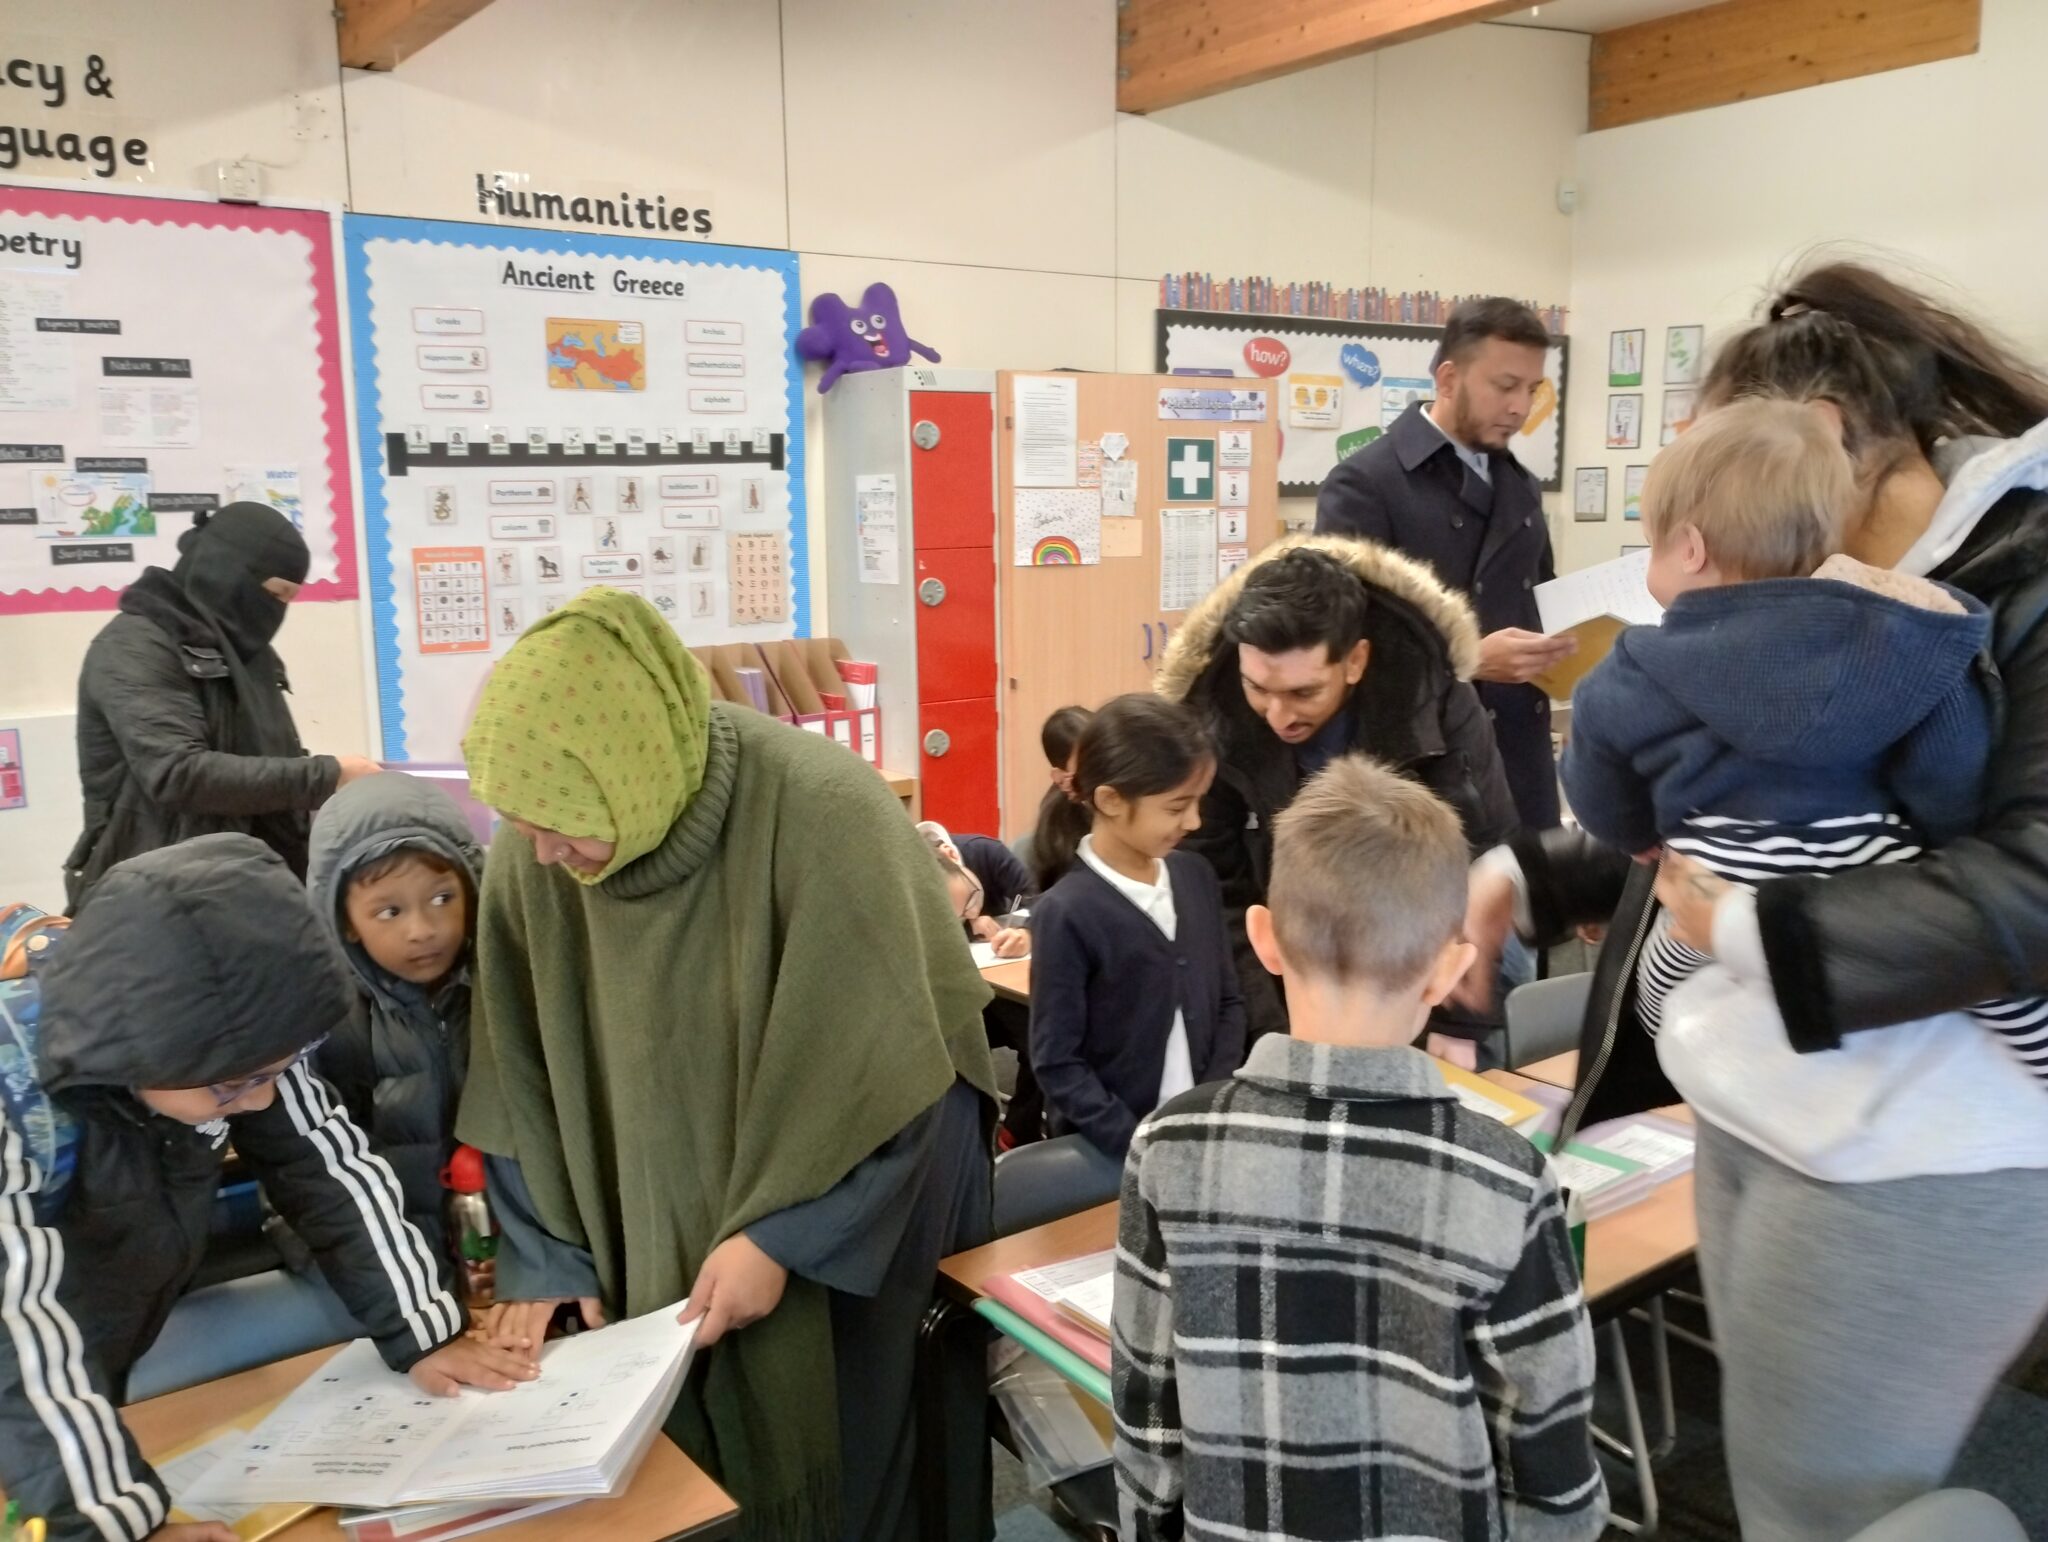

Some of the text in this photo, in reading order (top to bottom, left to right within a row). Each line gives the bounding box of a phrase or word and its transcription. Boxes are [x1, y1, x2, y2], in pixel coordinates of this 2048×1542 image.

[0, 54, 114, 108] cy &
[476, 173, 713, 234] Humanities
[502, 260, 685, 297] Ancient Greece
[1250, 343, 1288, 367] how?
[1342, 352, 1379, 379] where?
